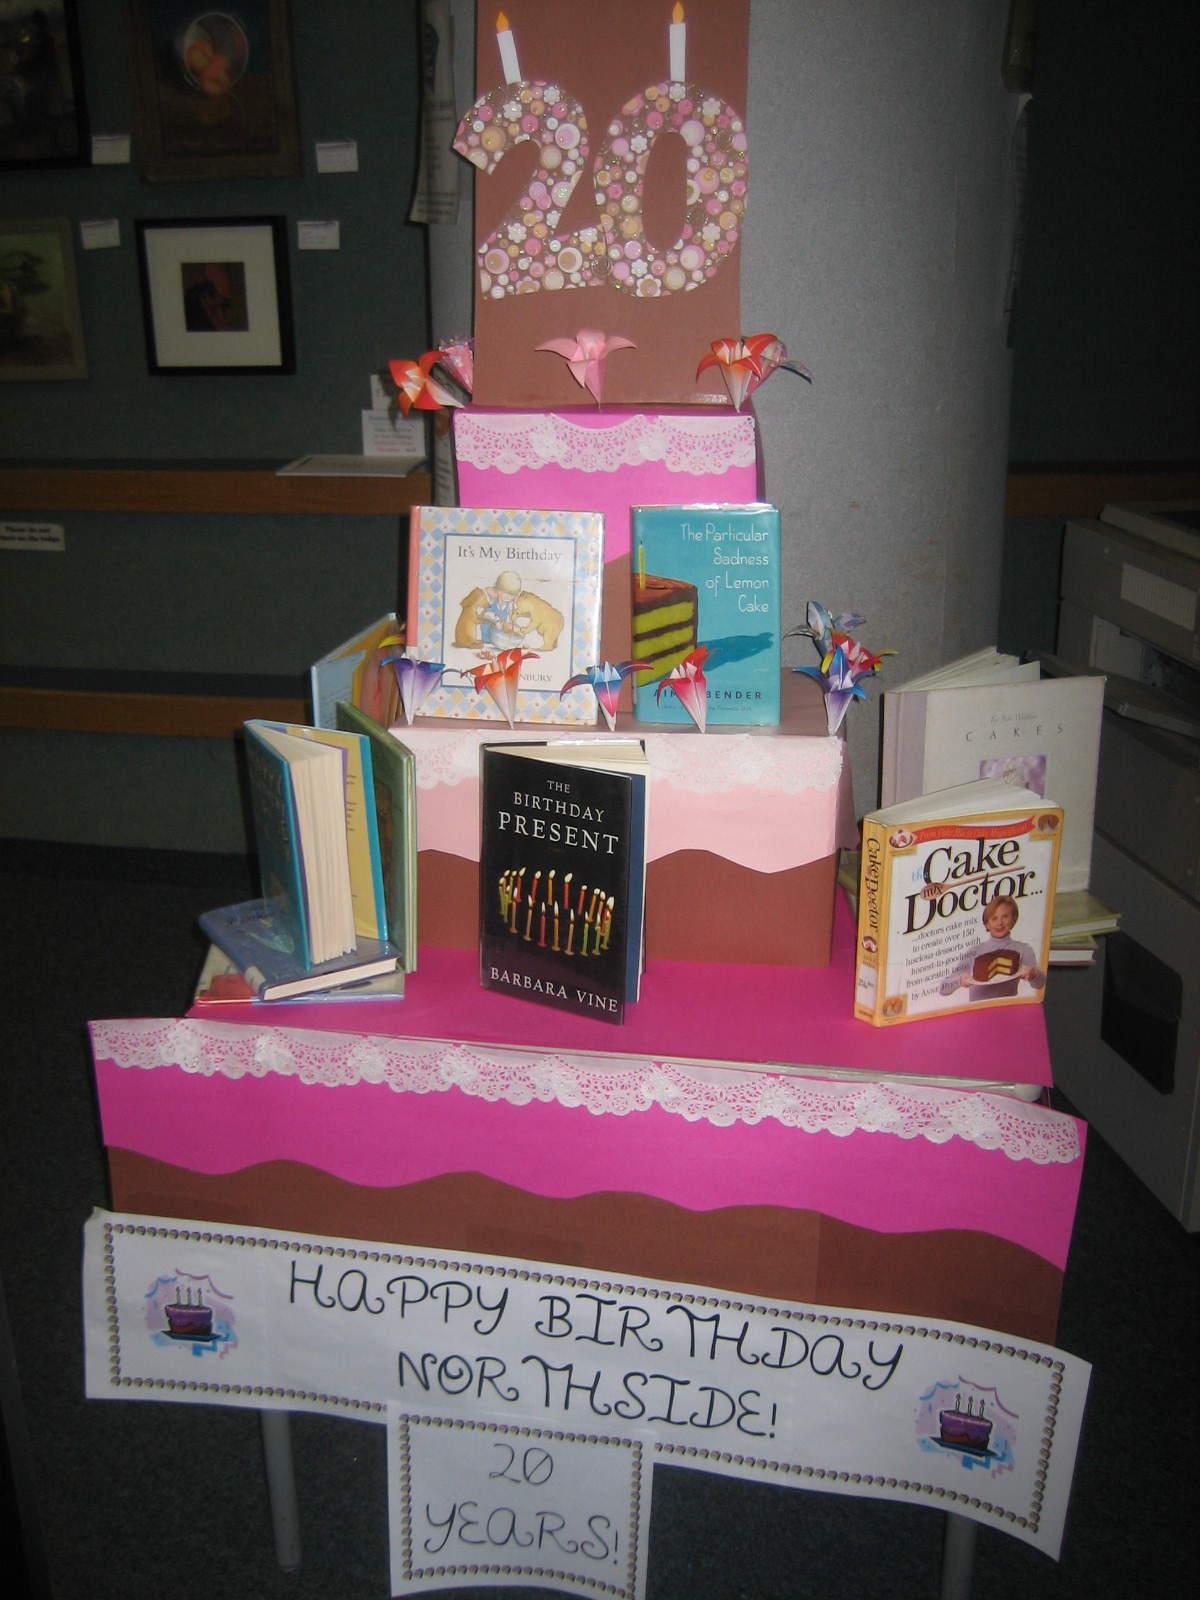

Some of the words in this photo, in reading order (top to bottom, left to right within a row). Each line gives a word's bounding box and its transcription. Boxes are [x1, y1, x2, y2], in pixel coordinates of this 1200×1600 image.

[453, 80, 748, 300] 20
[681, 523, 703, 541] The
[705, 522, 769, 541] Particular
[458, 545, 475, 558] It's
[480, 546, 502, 562] My
[507, 547, 562, 564] Birthday
[713, 546, 769, 566] Sadness
[705, 575, 722, 597] of
[725, 571, 769, 589] Lemon
[738, 594, 769, 613] Cake
[519, 673, 553, 682] NBURY
[706, 690, 762, 700] BENDER
[966, 723, 1063, 741] CAKES
[547, 780, 571, 794] THE
[514, 791, 604, 823] BIRTHDAY
[498, 811, 619, 854] PRESENT
[866, 838, 881, 879] Cake
[923, 837, 1020, 885] Cake
[864, 875, 880, 932] Doctor
[945, 921, 963, 932] cake
[964, 916, 978, 926] mix
[905, 952, 934, 967] luscious
[935, 943, 964, 957] desserts
[965, 936, 981, 947] with
[912, 944, 920, 953] to
[921, 939, 943, 950] create
[944, 933, 960, 942] over
[962, 928, 975, 938] 150
[490, 966, 568, 999] BARBARA
[576, 989, 618, 1012] VINE
[906, 968, 950, 988] from-scratch
[911, 993, 919, 1001] by
[921, 986, 940, 998] ANNE
[289, 1260, 508, 1335] HAPPY
[535, 1293, 903, 1390] BIRTHDAY
[398, 1351, 777, 1438] NORTHSIDE!
[489, 1443, 554, 1485] 20
[424, 1501, 619, 1564] YEARS!
